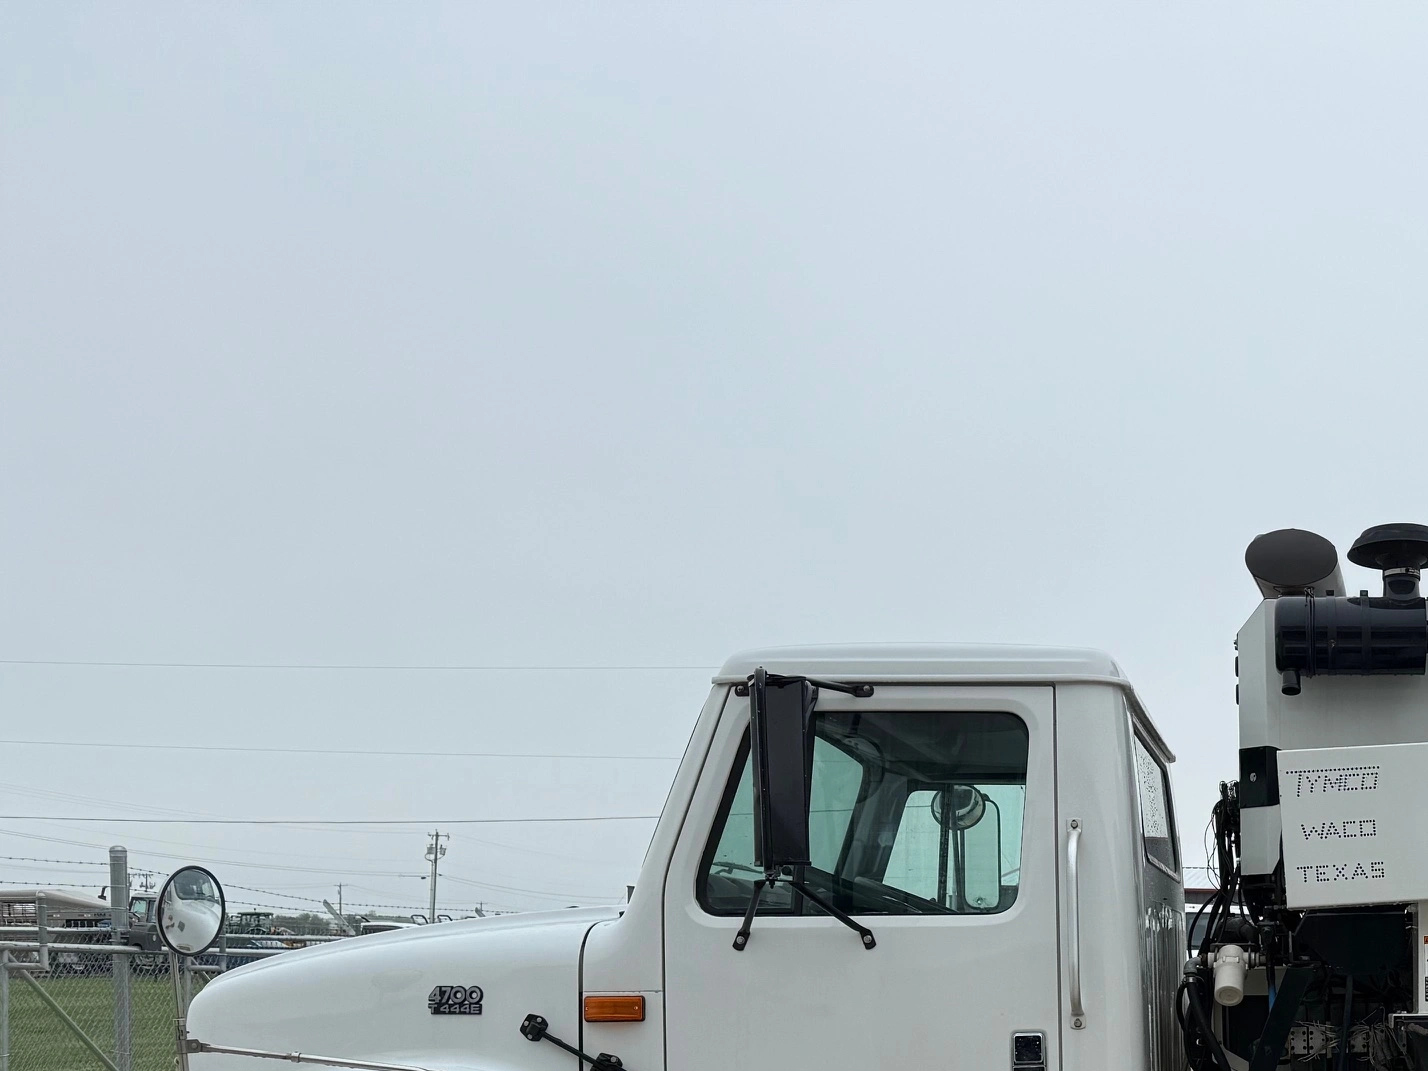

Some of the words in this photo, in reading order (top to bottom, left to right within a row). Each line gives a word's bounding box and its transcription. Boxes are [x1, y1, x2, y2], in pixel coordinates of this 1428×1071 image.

[1285, 766, 1380, 798] TYMCO
[1300, 819, 1377, 841] WACO
[1296, 861, 1385, 883] TEXAS
[428, 985, 484, 1004] 4700
[428, 1004, 438, 1014] T
[439, 1004, 481, 1014] 444E
